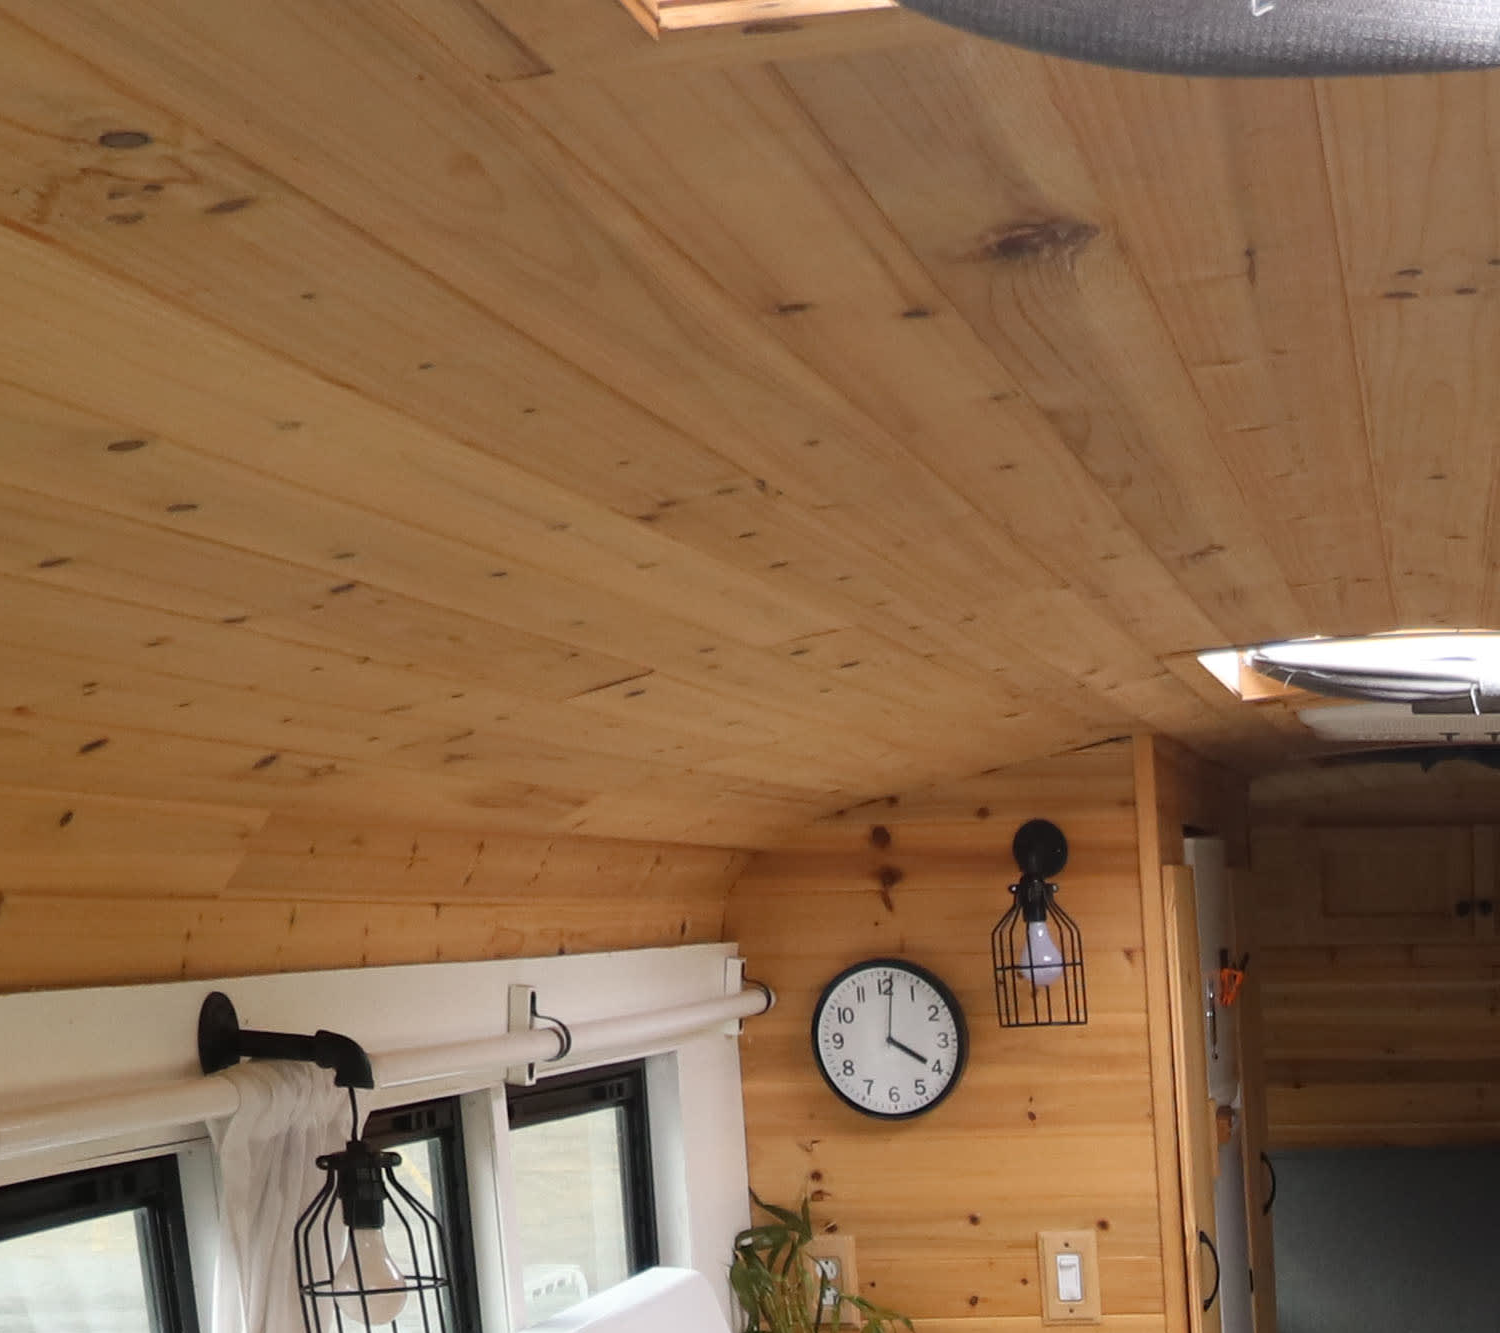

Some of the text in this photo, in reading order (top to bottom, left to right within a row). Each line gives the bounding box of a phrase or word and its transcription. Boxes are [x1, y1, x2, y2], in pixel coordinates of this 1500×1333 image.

[855, 985, 866, 1003] 11
[877, 978, 894, 995] 12
[837, 1006, 855, 1024] 10
[928, 1004, 940, 1022] 2
[832, 1032, 845, 1050] 9
[937, 1032, 949, 1049] 3
[842, 1060, 855, 1077] 8
[931, 1060, 943, 1076] 4
[862, 1079, 875, 1096] 7
[889, 1086, 901, 1103] 6
[914, 1079, 927, 1097] 5
